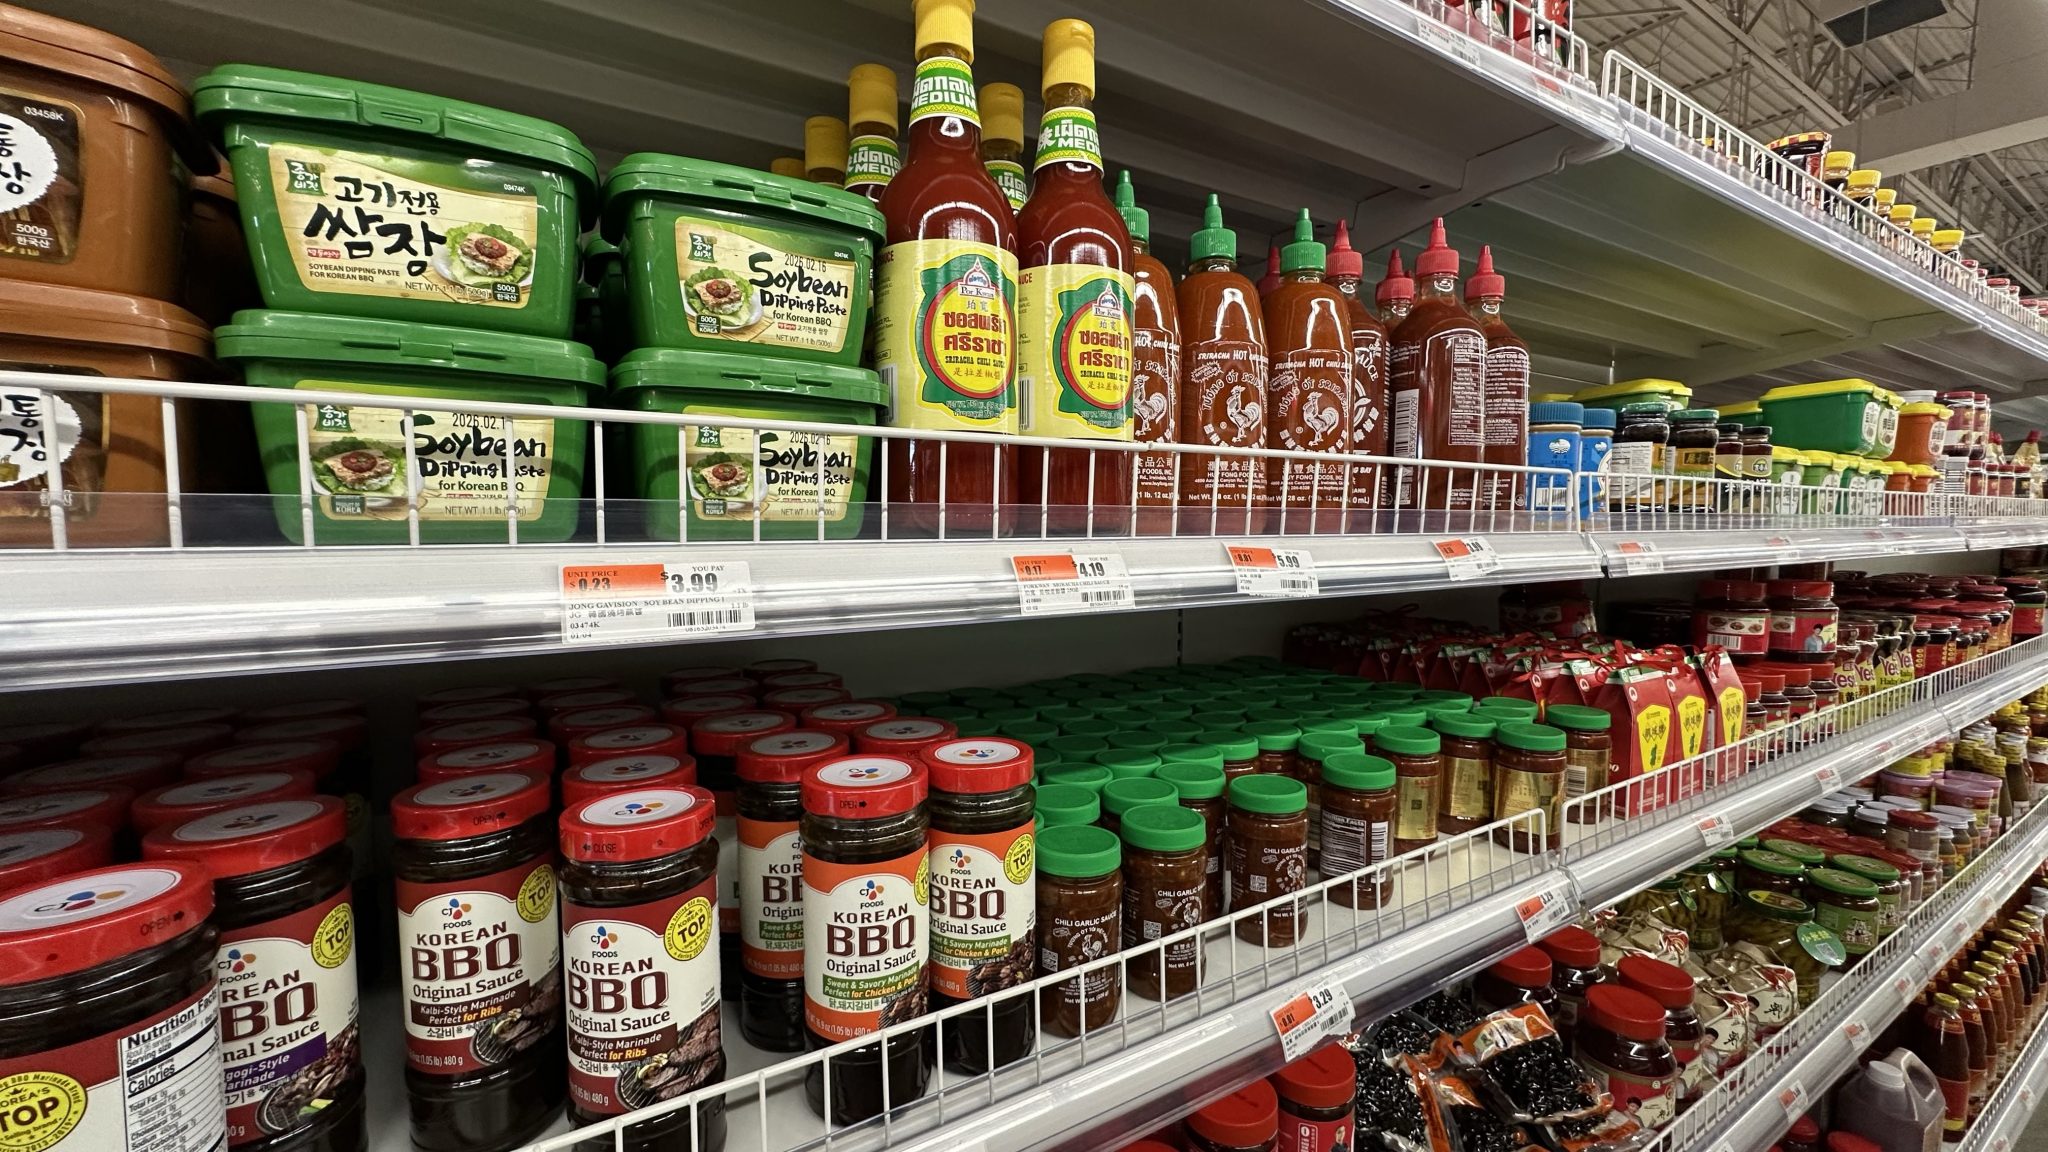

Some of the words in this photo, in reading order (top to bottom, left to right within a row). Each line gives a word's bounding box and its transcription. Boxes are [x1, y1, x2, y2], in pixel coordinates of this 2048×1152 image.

[911, 91, 976, 111] MEDIUM
[24, 106, 64, 121] 03458K
[503, 184, 526, 193] 03474K
[16, 223, 47, 236] 500g
[303, 203, 447, 277] 쌈장
[784, 253, 827, 272] 2026.02.16
[309, 264, 344, 272] SOYBEAN
[345, 266, 376, 275] DIPPING
[377, 269, 400, 277] PASTE
[327, 272, 357, 281] KOREAN
[749, 252, 848, 298] Soybean
[405, 281, 423, 290] NET
[496, 283, 515, 294] 500g
[816, 300, 847, 316] Paste
[700, 316, 717, 324] 500g
[773, 311, 785, 320] for
[786, 312, 814, 324] Korean
[815, 316, 832, 327] BBQ
[815, 338, 832, 347] (500g)
[977, 357, 991, 366] CHILI
[1233, 350, 1247, 360] HOT
[1309, 358, 1324, 368] HOT
[1107, 372, 1118, 380] CHILI
[400, 414, 546, 459] Soybean
[439, 481, 456, 490] for
[458, 481, 498, 491] Korean
[791, 488, 818, 496] Korean
[445, 506, 462, 514] NET
[1080, 562, 1105, 576] 4.19
[1277, 555, 1299, 568] 5.99
[1025, 566, 1042, 575] 0.17
[578, 578, 611, 591] 0.23
[672, 573, 718, 593] 3.99
[568, 601, 594, 610] JONG
[596, 600, 638, 609] GAVISION
[686, 596, 720, 604] DIPPING
[570, 621, 600, 629] 03474K
[1854, 664, 1875, 681] Yes
[1878, 656, 1899, 676] Yes
[840, 801, 859, 809] OPEN
[593, 843, 617, 853] CLOSE
[1281, 846, 1300, 855] GARLIC
[1013, 849, 1031, 872] TOP
[932, 871, 996, 890] KOREAN
[528, 881, 550, 902] TOP
[859, 888, 869, 897] CJ
[1158, 889, 1176, 897] CHILI
[1177, 888, 1197, 898] GARLIC
[860, 900, 884, 909] FOODS
[929, 883, 1006, 920] BBQ
[441, 907, 453, 918] CJ
[834, 903, 908, 924] KOREAN
[1055, 918, 1073, 926] CHILI
[1074, 918, 1100, 927] GARLIC
[1100, 910, 1117, 923] SAUCE
[443, 919, 472, 930] FOODS
[678, 914, 705, 943] TOP
[972, 923, 1007, 934] Sauce
[325, 922, 350, 952] TOP
[416, 921, 507, 947] KOREAN
[590, 934, 601, 946] CJ
[826, 914, 916, 958] BBQ
[949, 938, 974, 949] Savory
[975, 938, 1008, 948] Marinade
[410, 933, 522, 982] BBQ
[592, 950, 618, 959] FOODS
[954, 947, 982, 957] Chicken
[991, 946, 1008, 956] Pork
[571, 957, 653, 976] KOREAN
[826, 959, 880, 977] Original
[884, 948, 917, 967] Sauce
[219, 971, 256, 986] FOODS
[413, 982, 472, 1002] Original
[475, 968, 524, 993] Sauce
[827, 978, 849, 989] Sweet
[858, 977, 885, 990] Savory
[887, 966, 917, 984] Marinade
[567, 968, 669, 1015] BBQ
[824, 986, 850, 997] Perfect
[851, 989, 863, 999] for
[864, 984, 896, 998] Chicken
[903, 976, 918, 989] Pork
[420, 1000, 468, 1016] Kalbi-Style
[470, 989, 517, 1012] Marinade
[1313, 988, 1333, 1009] 3.29
[429, 1014, 462, 1025] Perfect
[463, 1010, 478, 1022] for
[480, 1006, 502, 1018] Ribs
[569, 1015, 617, 1033] Original
[621, 1010, 671, 1032] Sauce
[127, 1009, 195, 1049] Nutrition
[262, 1020, 320, 1053] Sauce
[574, 1032, 613, 1049] Kalbi-Style
[616, 1032, 662, 1049] Marinade
[126, 1050, 156, 1068] Serving
[444, 1055, 456, 1066] 480
[580, 1046, 607, 1060] Perfect
[609, 1049, 623, 1060] for
[625, 1048, 648, 1058] Ribs
[128, 1063, 176, 1094] Calories
[591, 1090, 602, 1105] 480
[0, 1097, 59, 1132] TOP
